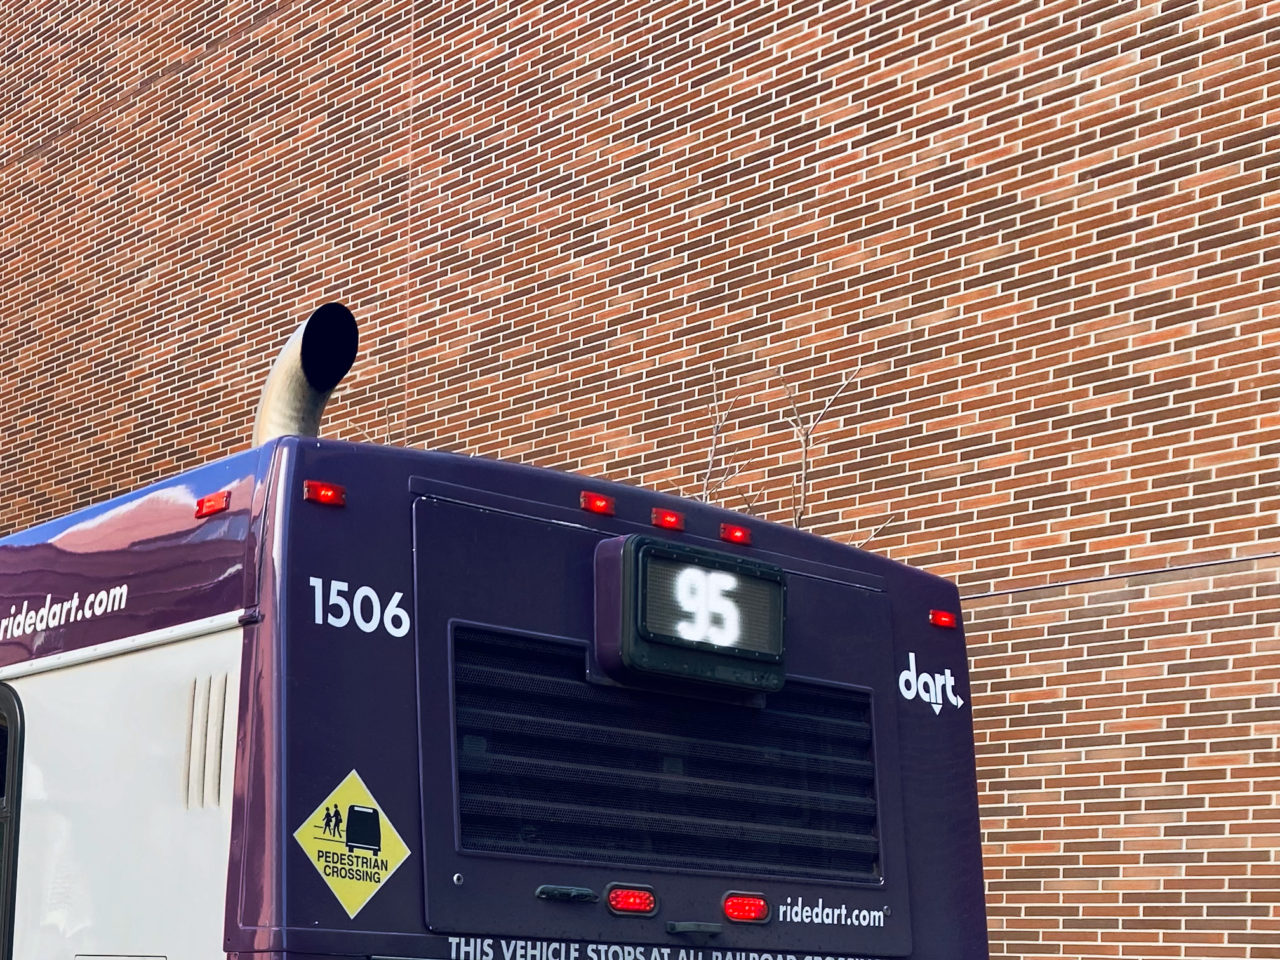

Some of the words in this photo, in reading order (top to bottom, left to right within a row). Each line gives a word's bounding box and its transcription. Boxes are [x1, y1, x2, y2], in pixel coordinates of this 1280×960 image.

[309, 576, 412, 638] 1506
[674, 566, 741, 647] 95
[898, 652, 960, 706] dart
[317, 850, 388, 872] PEDESTRIAN
[323, 864, 381, 884] CROSSING
[778, 897, 885, 927] ridedart.com
